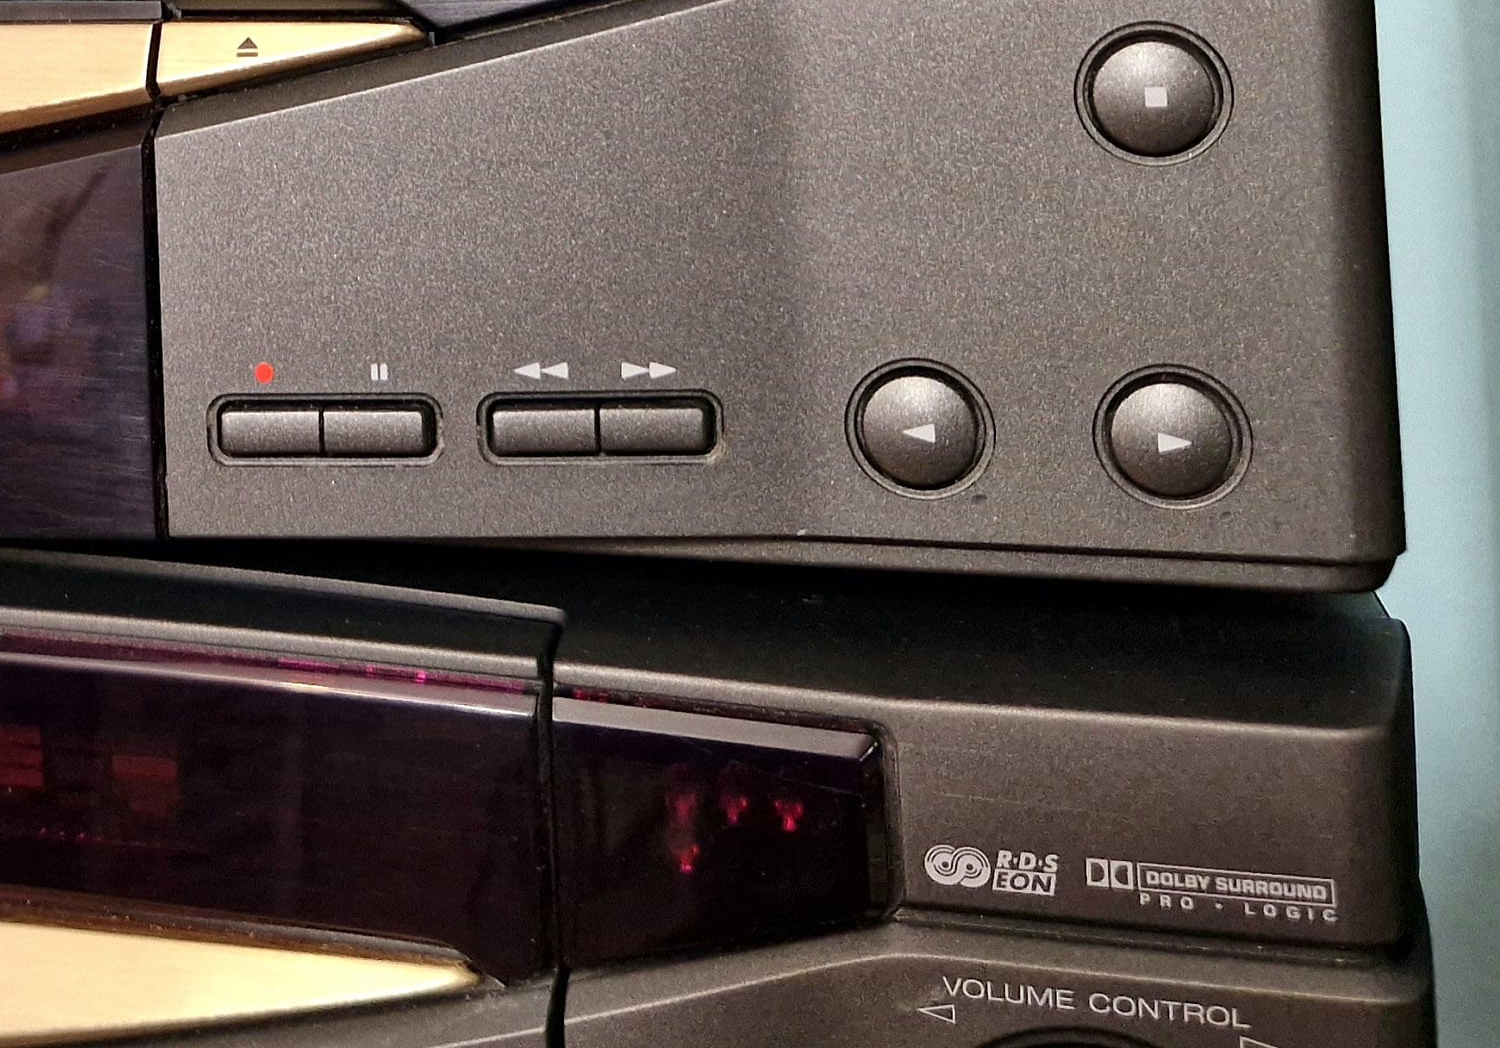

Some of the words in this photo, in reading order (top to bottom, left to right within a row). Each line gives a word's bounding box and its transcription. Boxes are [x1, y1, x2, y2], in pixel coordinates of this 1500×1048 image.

[1145, 870, 1209, 890] DOLBY
[1215, 876, 1326, 900] SURROUND
[943, 976, 1075, 1010] VOLUME
[1089, 993, 1251, 1029] CONTROL
